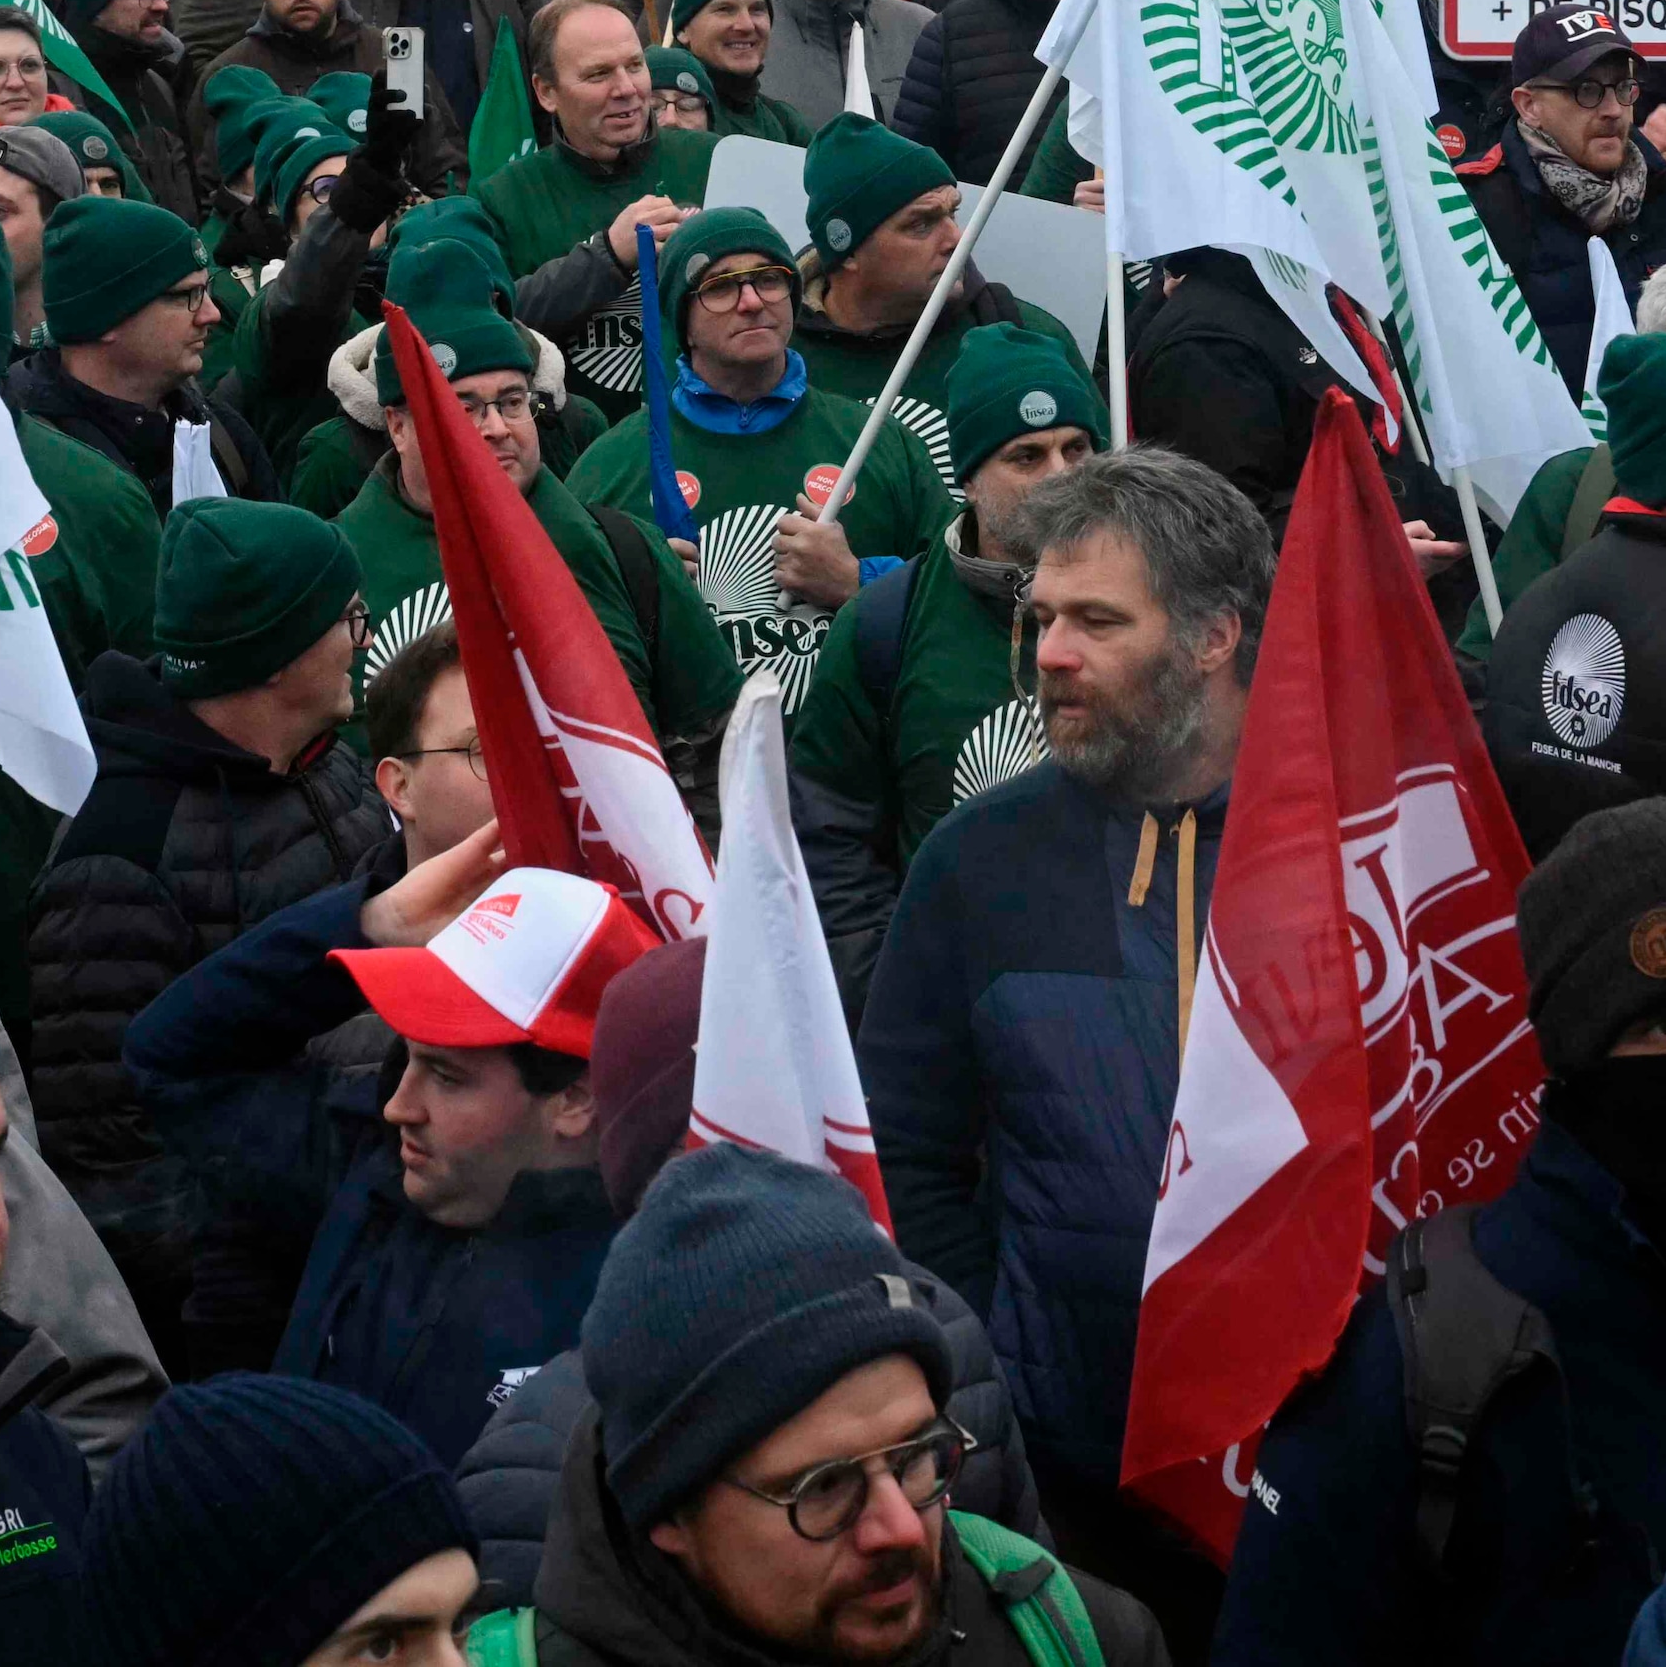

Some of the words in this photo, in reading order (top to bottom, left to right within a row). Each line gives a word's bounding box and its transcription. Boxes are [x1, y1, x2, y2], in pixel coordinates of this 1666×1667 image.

[831, 228, 851, 247] fnsea
[1024, 407, 1054, 421] fnsea
[807, 480, 832, 493] MERCO
[816, 475, 834, 485] NON
[1552, 669, 1613, 720] fdsea
[1531, 742, 1559, 758] FDSEA
[1561, 747, 1572, 761] DE
[1574, 750, 1586, 764] LA
[1586, 752, 1622, 774] MANCHE
